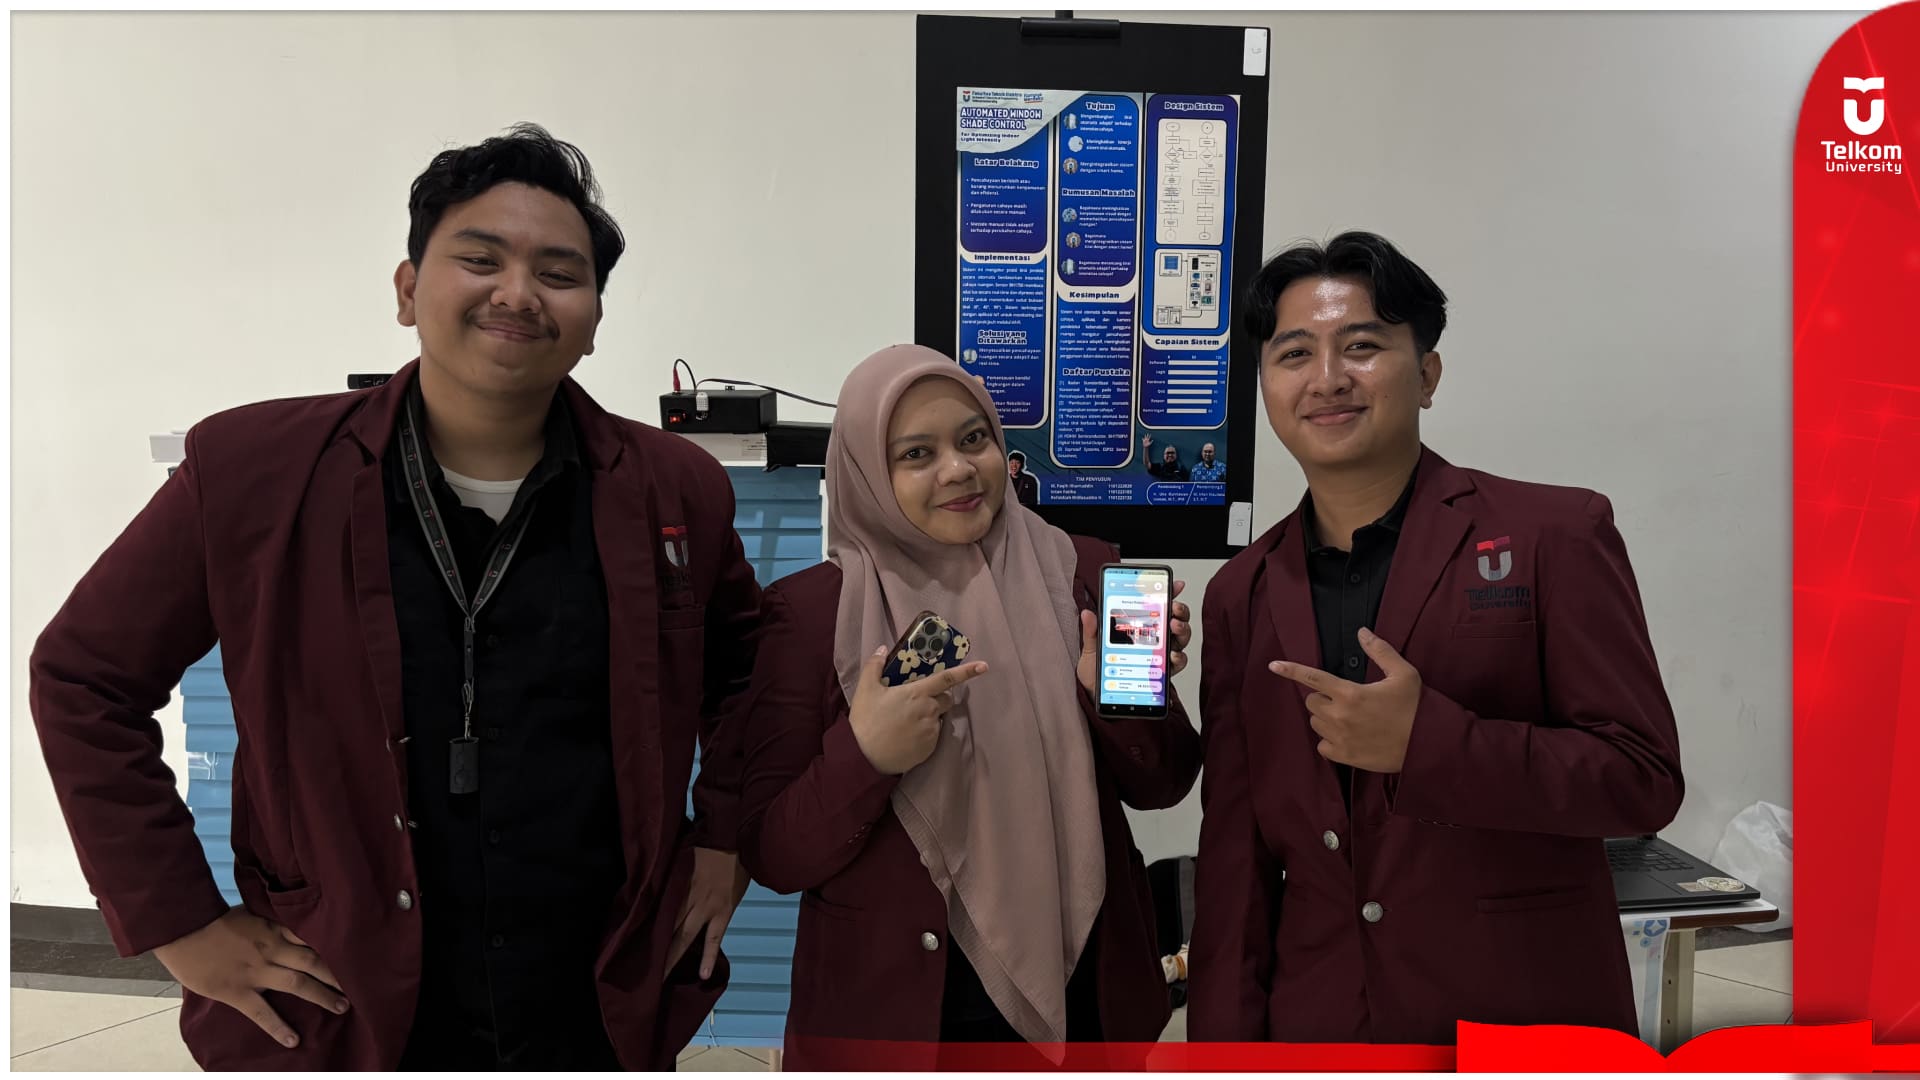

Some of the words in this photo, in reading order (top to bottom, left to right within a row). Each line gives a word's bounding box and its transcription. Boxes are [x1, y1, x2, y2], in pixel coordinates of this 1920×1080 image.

[1085, 102, 1116, 111] Tujuan
[1164, 102, 1194, 111] Design
[1195, 102, 1224, 111] Sistem
[961, 108, 1008, 118] AUTOMATED
[1009, 108, 1042, 119] WINDOW
[961, 119, 988, 128] SHADE
[989, 120, 1026, 129] CONTROL
[974, 158, 998, 166] Latar
[998, 158, 1039, 168] Belakang
[1061, 188, 1101, 196] Rumusan
[1100, 188, 1136, 197] Masalah
[1069, 291, 1120, 299] Kesimpulan
[978, 330, 1005, 338] Solusi
[977, 337, 1028, 345] Ditawarkan
[1062, 367, 1093, 376] Daftar
[1093, 367, 1131, 376] Pustaka
